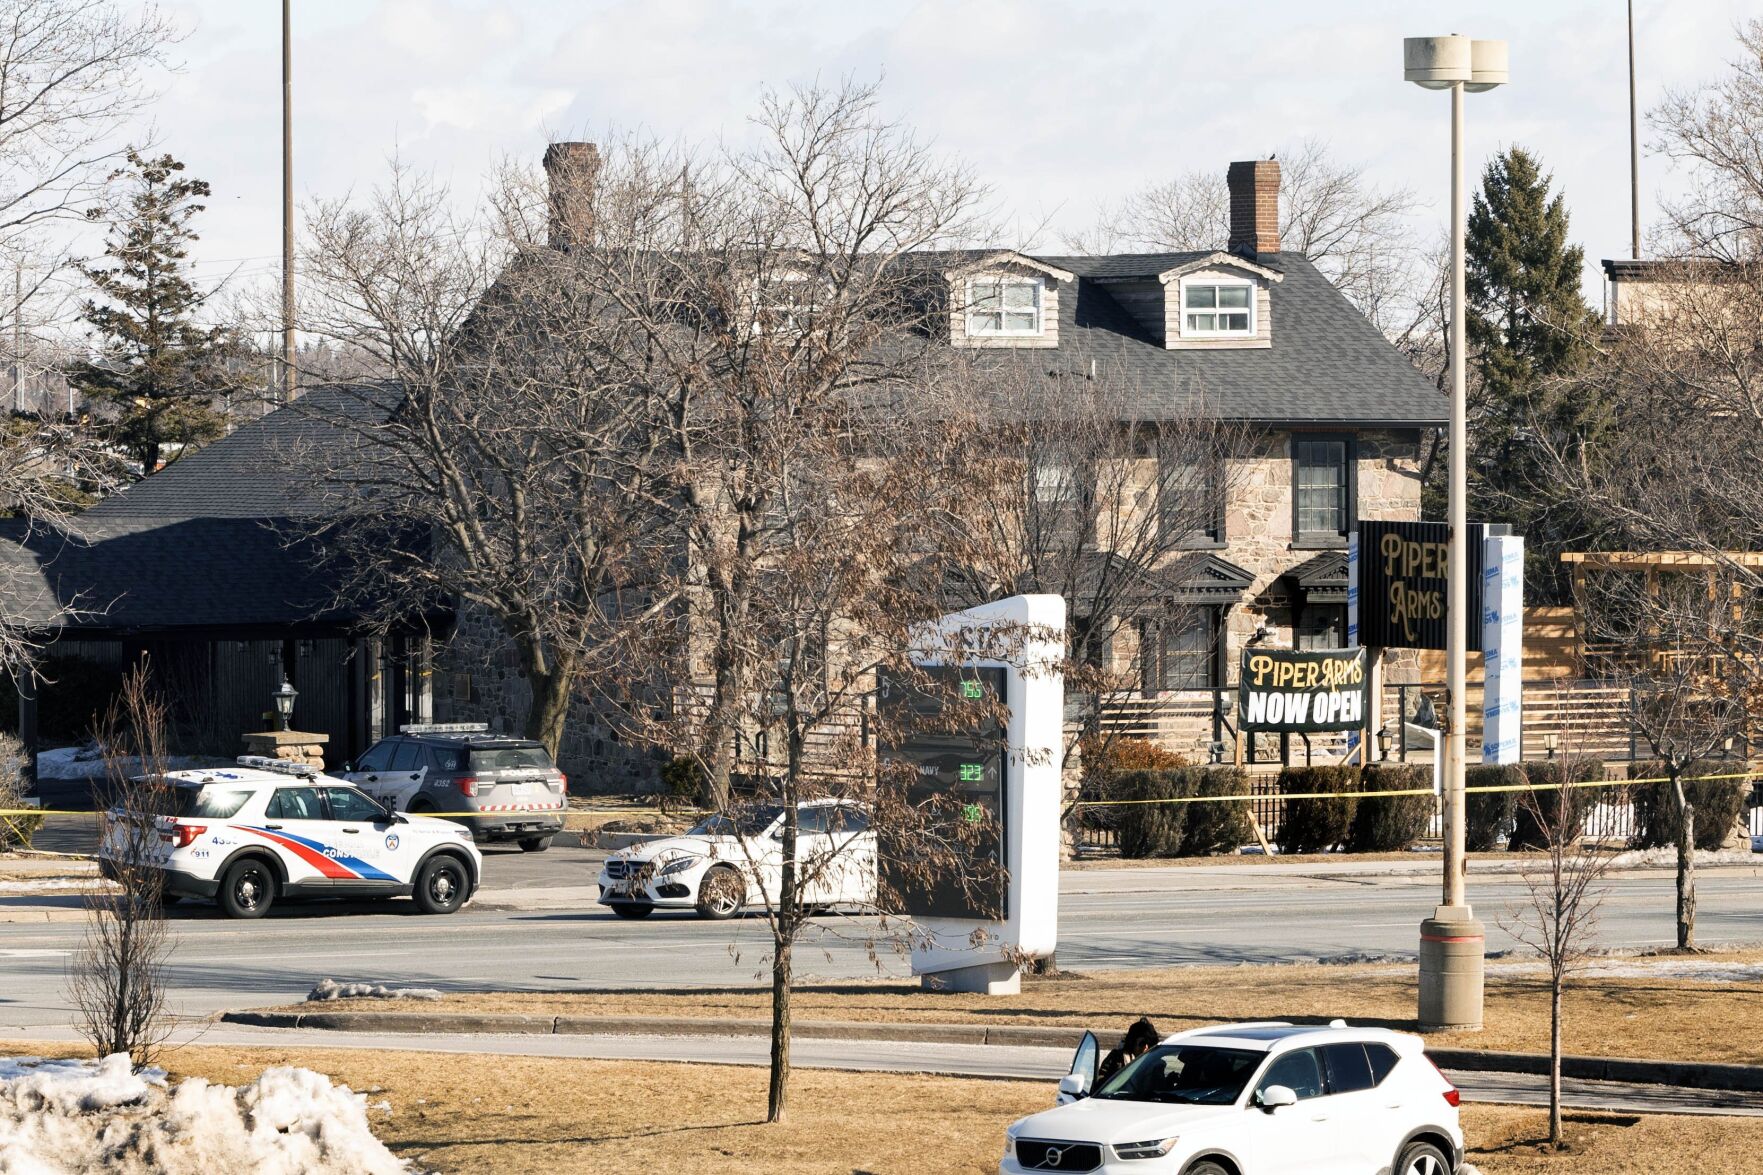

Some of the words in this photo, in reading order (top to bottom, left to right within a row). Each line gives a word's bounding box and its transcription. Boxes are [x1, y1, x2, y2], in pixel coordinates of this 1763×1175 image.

[1381, 533, 1448, 580] PIPER
[1390, 581, 1441, 641] ARMS
[1250, 655, 1319, 688] PIPER
[1322, 658, 1362, 693] ARMS
[1247, 691, 1310, 724] NOW
[1313, 690, 1362, 724] OPEN
[500, 769, 540, 777] POLICE
[960, 764, 981, 781] 323
